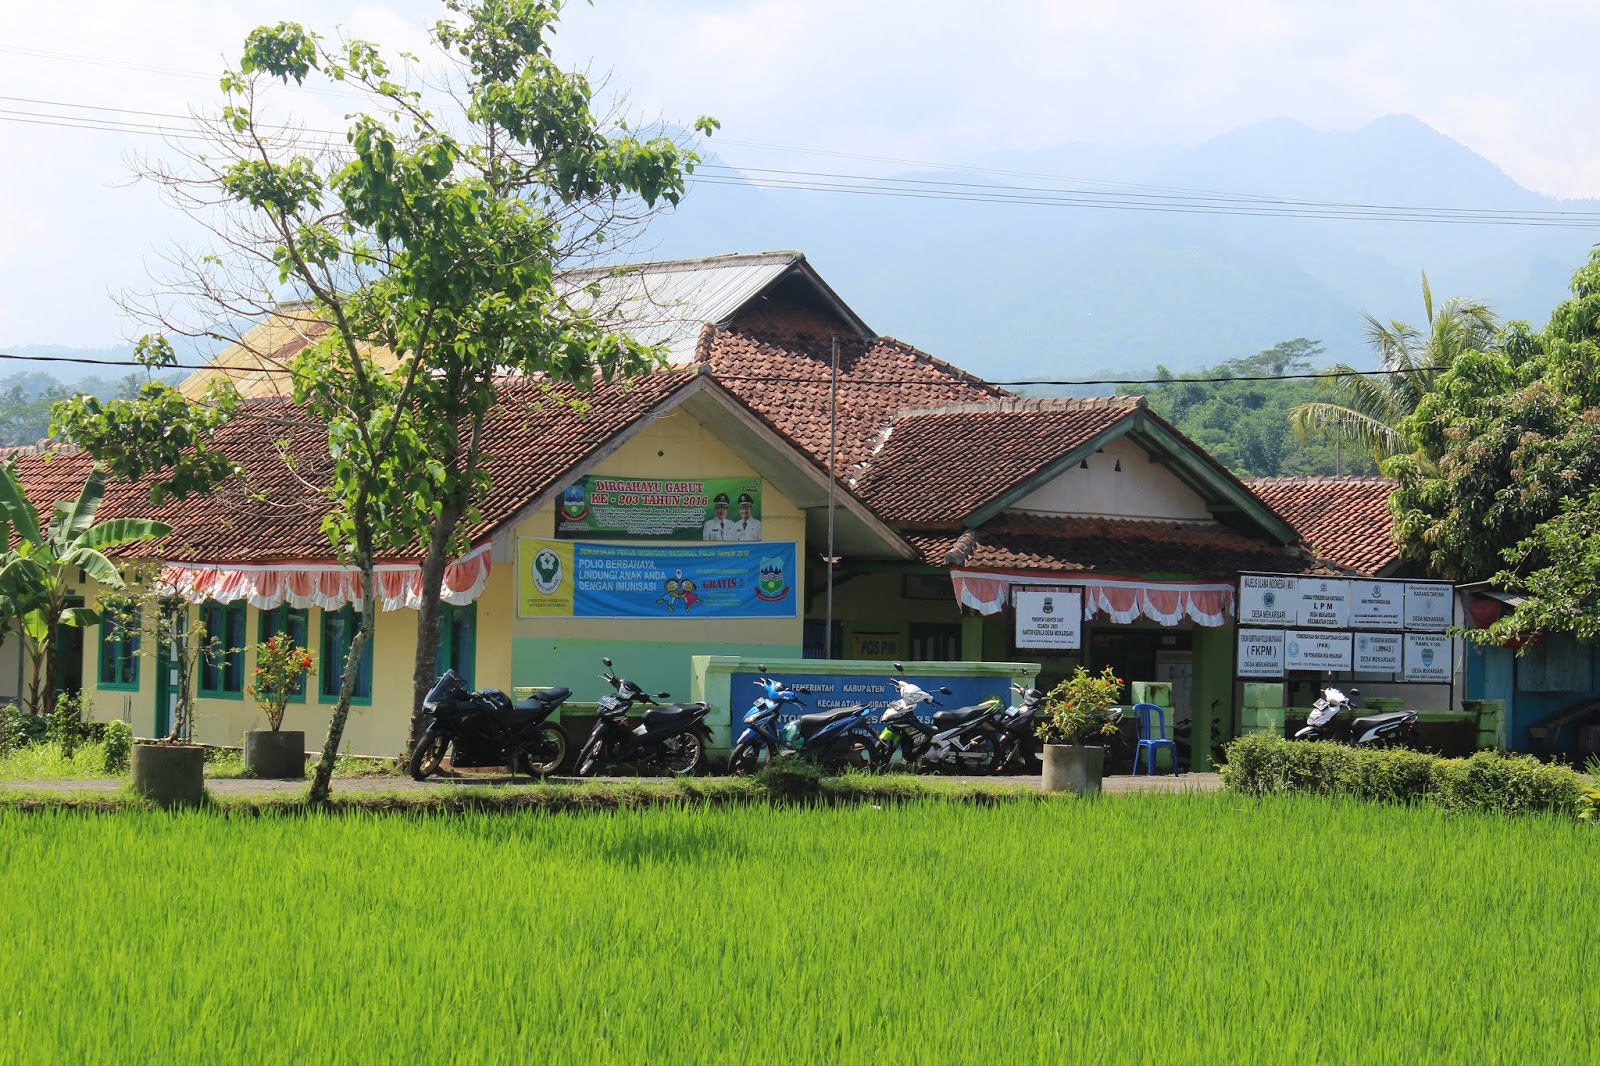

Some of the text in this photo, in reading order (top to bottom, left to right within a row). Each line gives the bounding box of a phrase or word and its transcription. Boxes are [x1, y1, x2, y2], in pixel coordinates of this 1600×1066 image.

[595, 480, 704, 494] DIRGAHAYU GARUT
[591, 493, 609, 504] KE
[618, 495, 639, 505] 203
[642, 495, 680, 505] TAHUN
[683, 496, 708, 506] 2016
[579, 559, 657, 570] POLIO BERBAHAYA,
[579, 570, 667, 580] LINDUNGI ANAK ANDA
[579, 581, 657, 591] DENGAN IMUNISASI
[703, 578, 737, 590] GRATIS
[1251, 610, 1286, 619] DESA MEKARSARI
[860, 639, 879, 656] POS
[791, 684, 834, 692] PEMERINTAH
[843, 684, 885, 693] KABUPATEN
